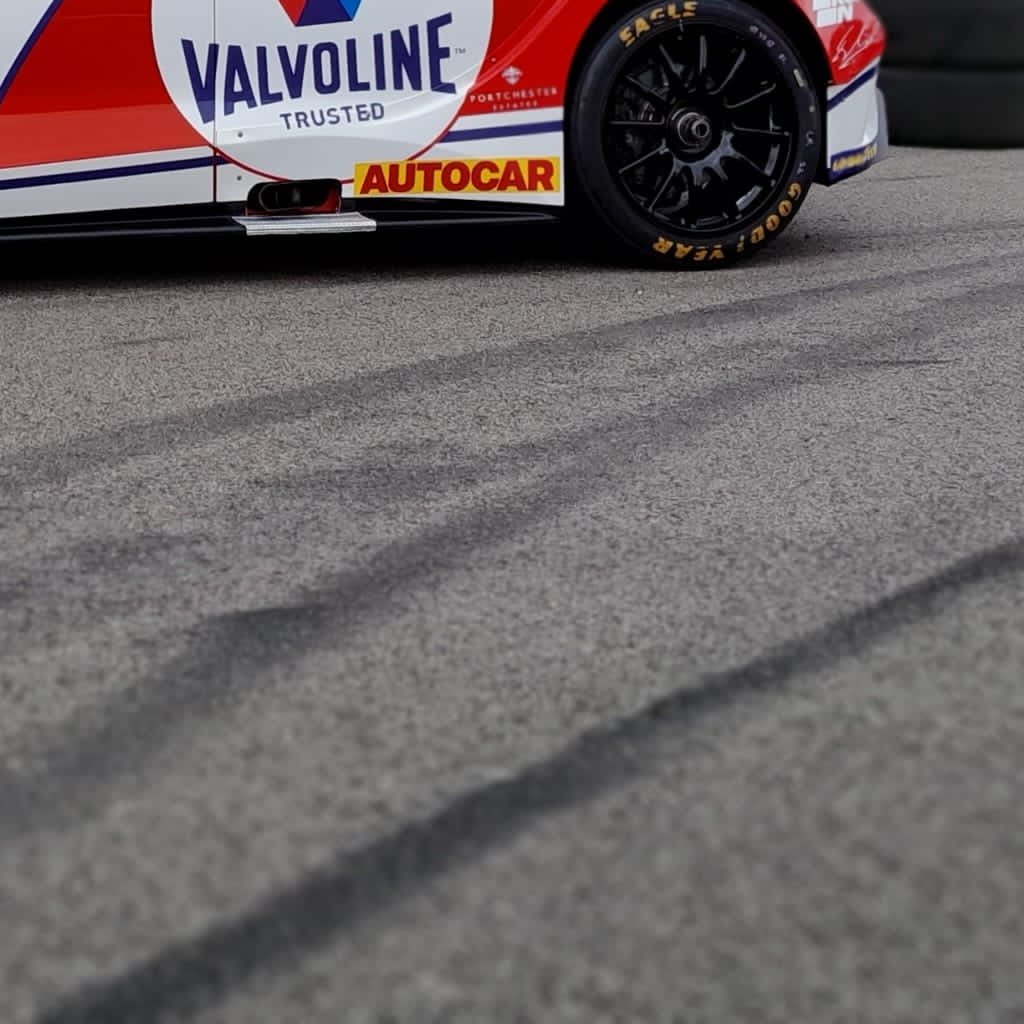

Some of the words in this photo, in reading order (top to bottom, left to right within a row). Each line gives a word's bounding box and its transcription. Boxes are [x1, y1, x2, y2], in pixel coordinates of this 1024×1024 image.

[618, 0, 698, 47] EAGLE
[180, 12, 457, 125] VALVOLINE
[280, 103, 385, 130] TRUSTED
[360, 160, 555, 195] AUTOCAR
